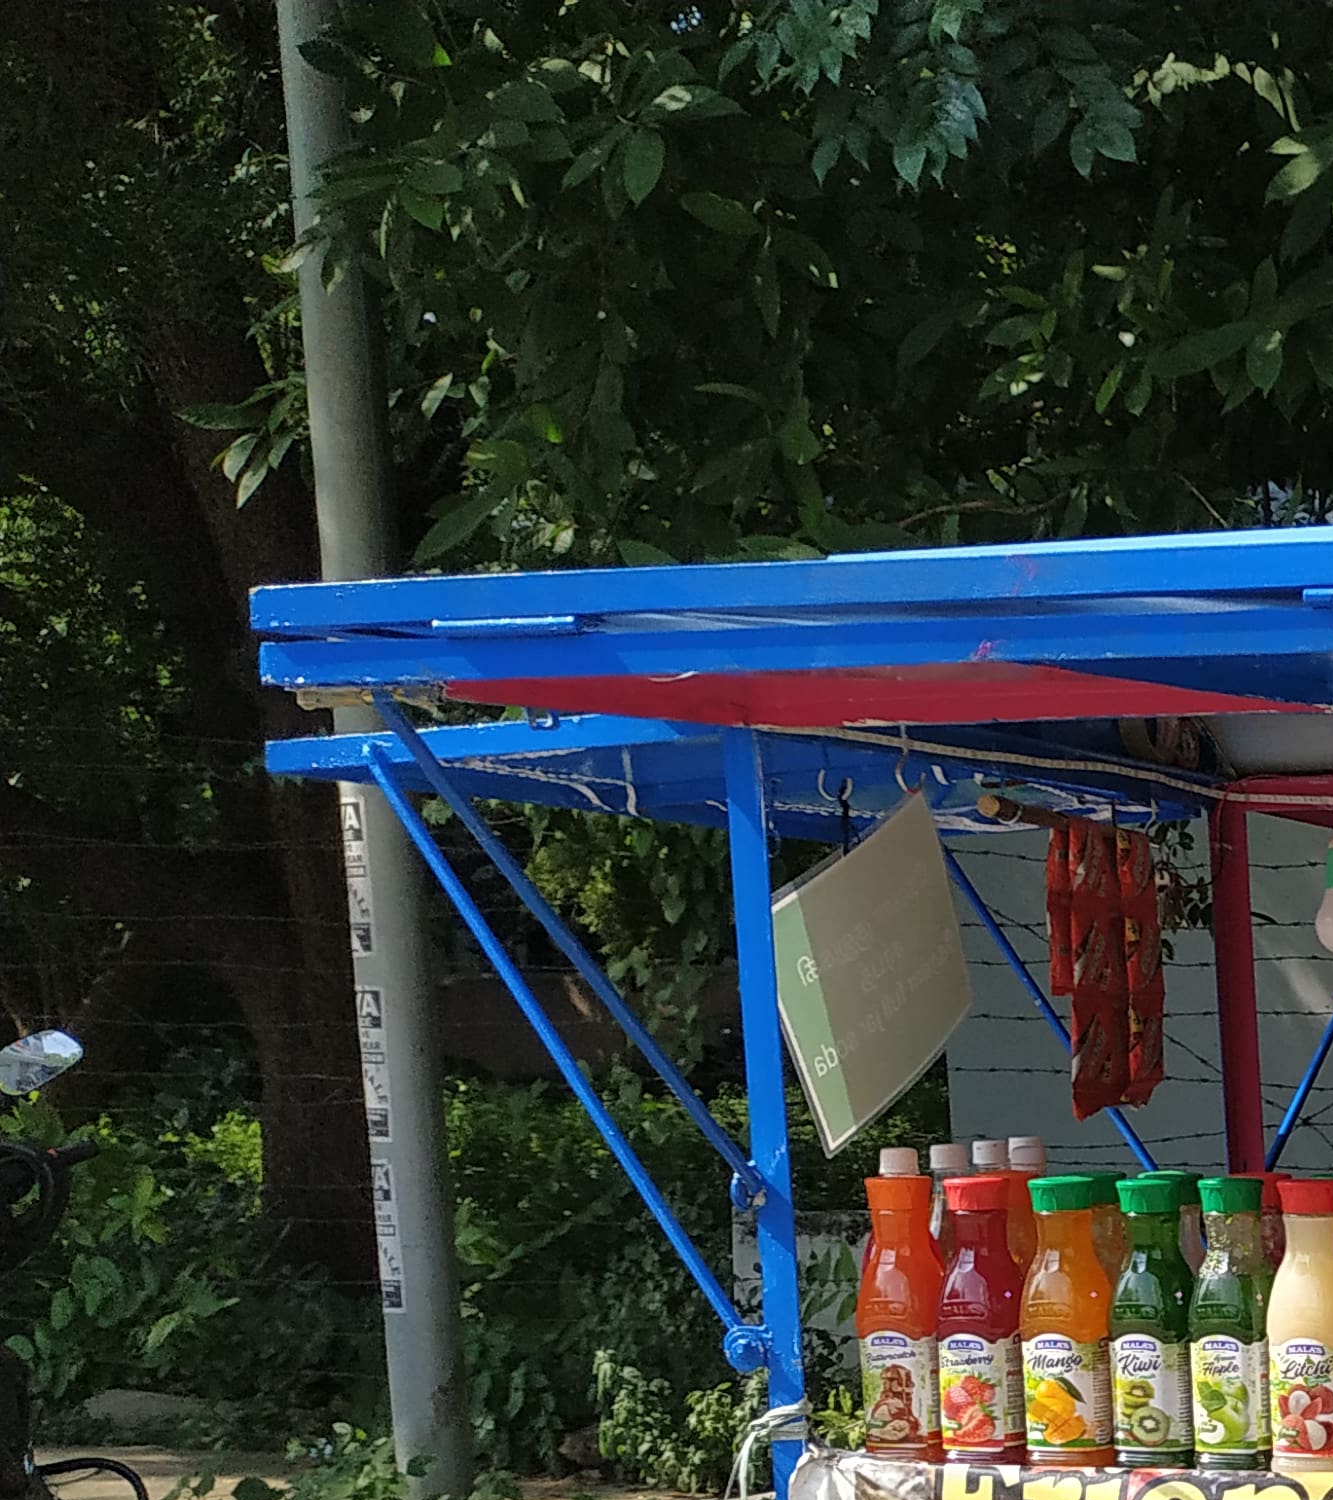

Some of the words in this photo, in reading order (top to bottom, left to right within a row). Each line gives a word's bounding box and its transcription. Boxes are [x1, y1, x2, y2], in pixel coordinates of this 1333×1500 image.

[1027, 1352, 1083, 1372] Mango
[1118, 1352, 1162, 1376] Kiwi
[1202, 1361, 1240, 1377] Apple
